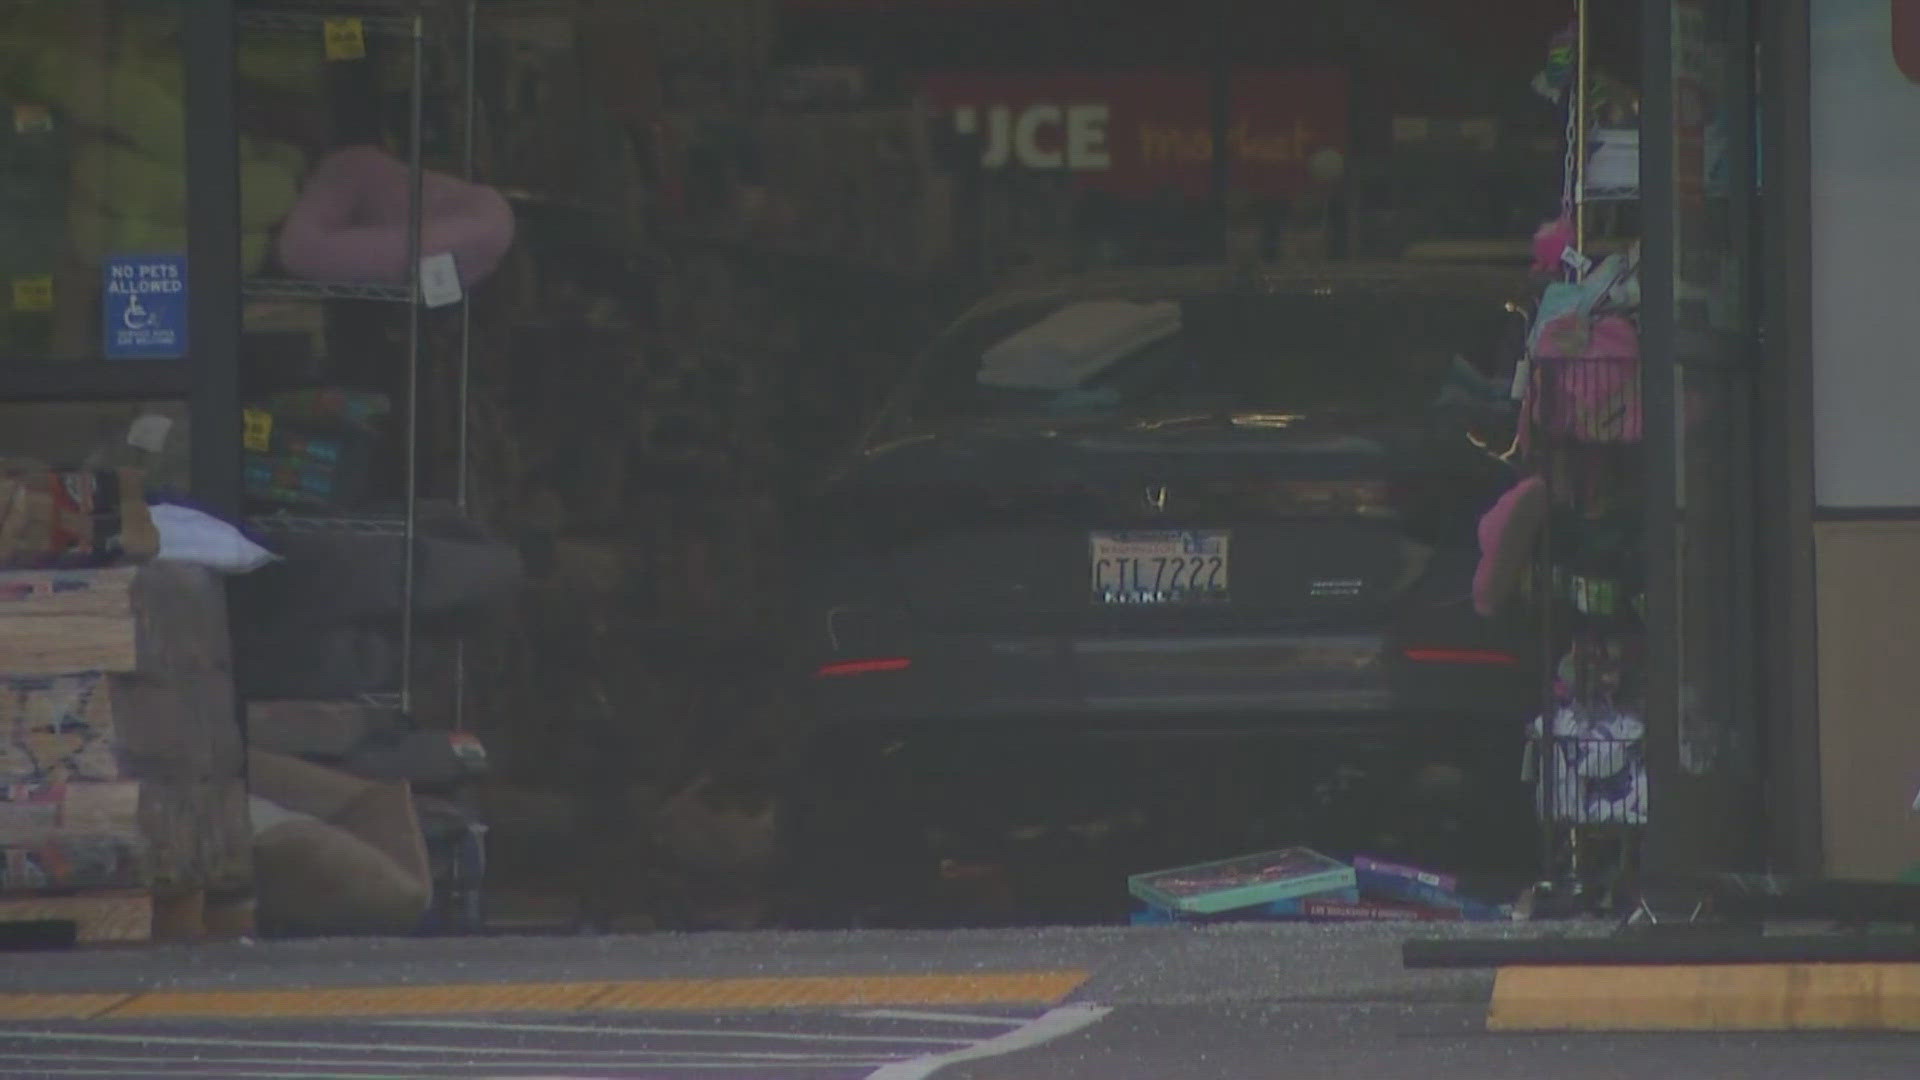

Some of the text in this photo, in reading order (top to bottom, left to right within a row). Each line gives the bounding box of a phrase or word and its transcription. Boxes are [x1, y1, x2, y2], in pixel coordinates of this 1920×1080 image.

[111, 264, 178, 278] NO PETS
[108, 280, 183, 293] ALLOWED
[1096, 557, 1223, 591] CTL7222
